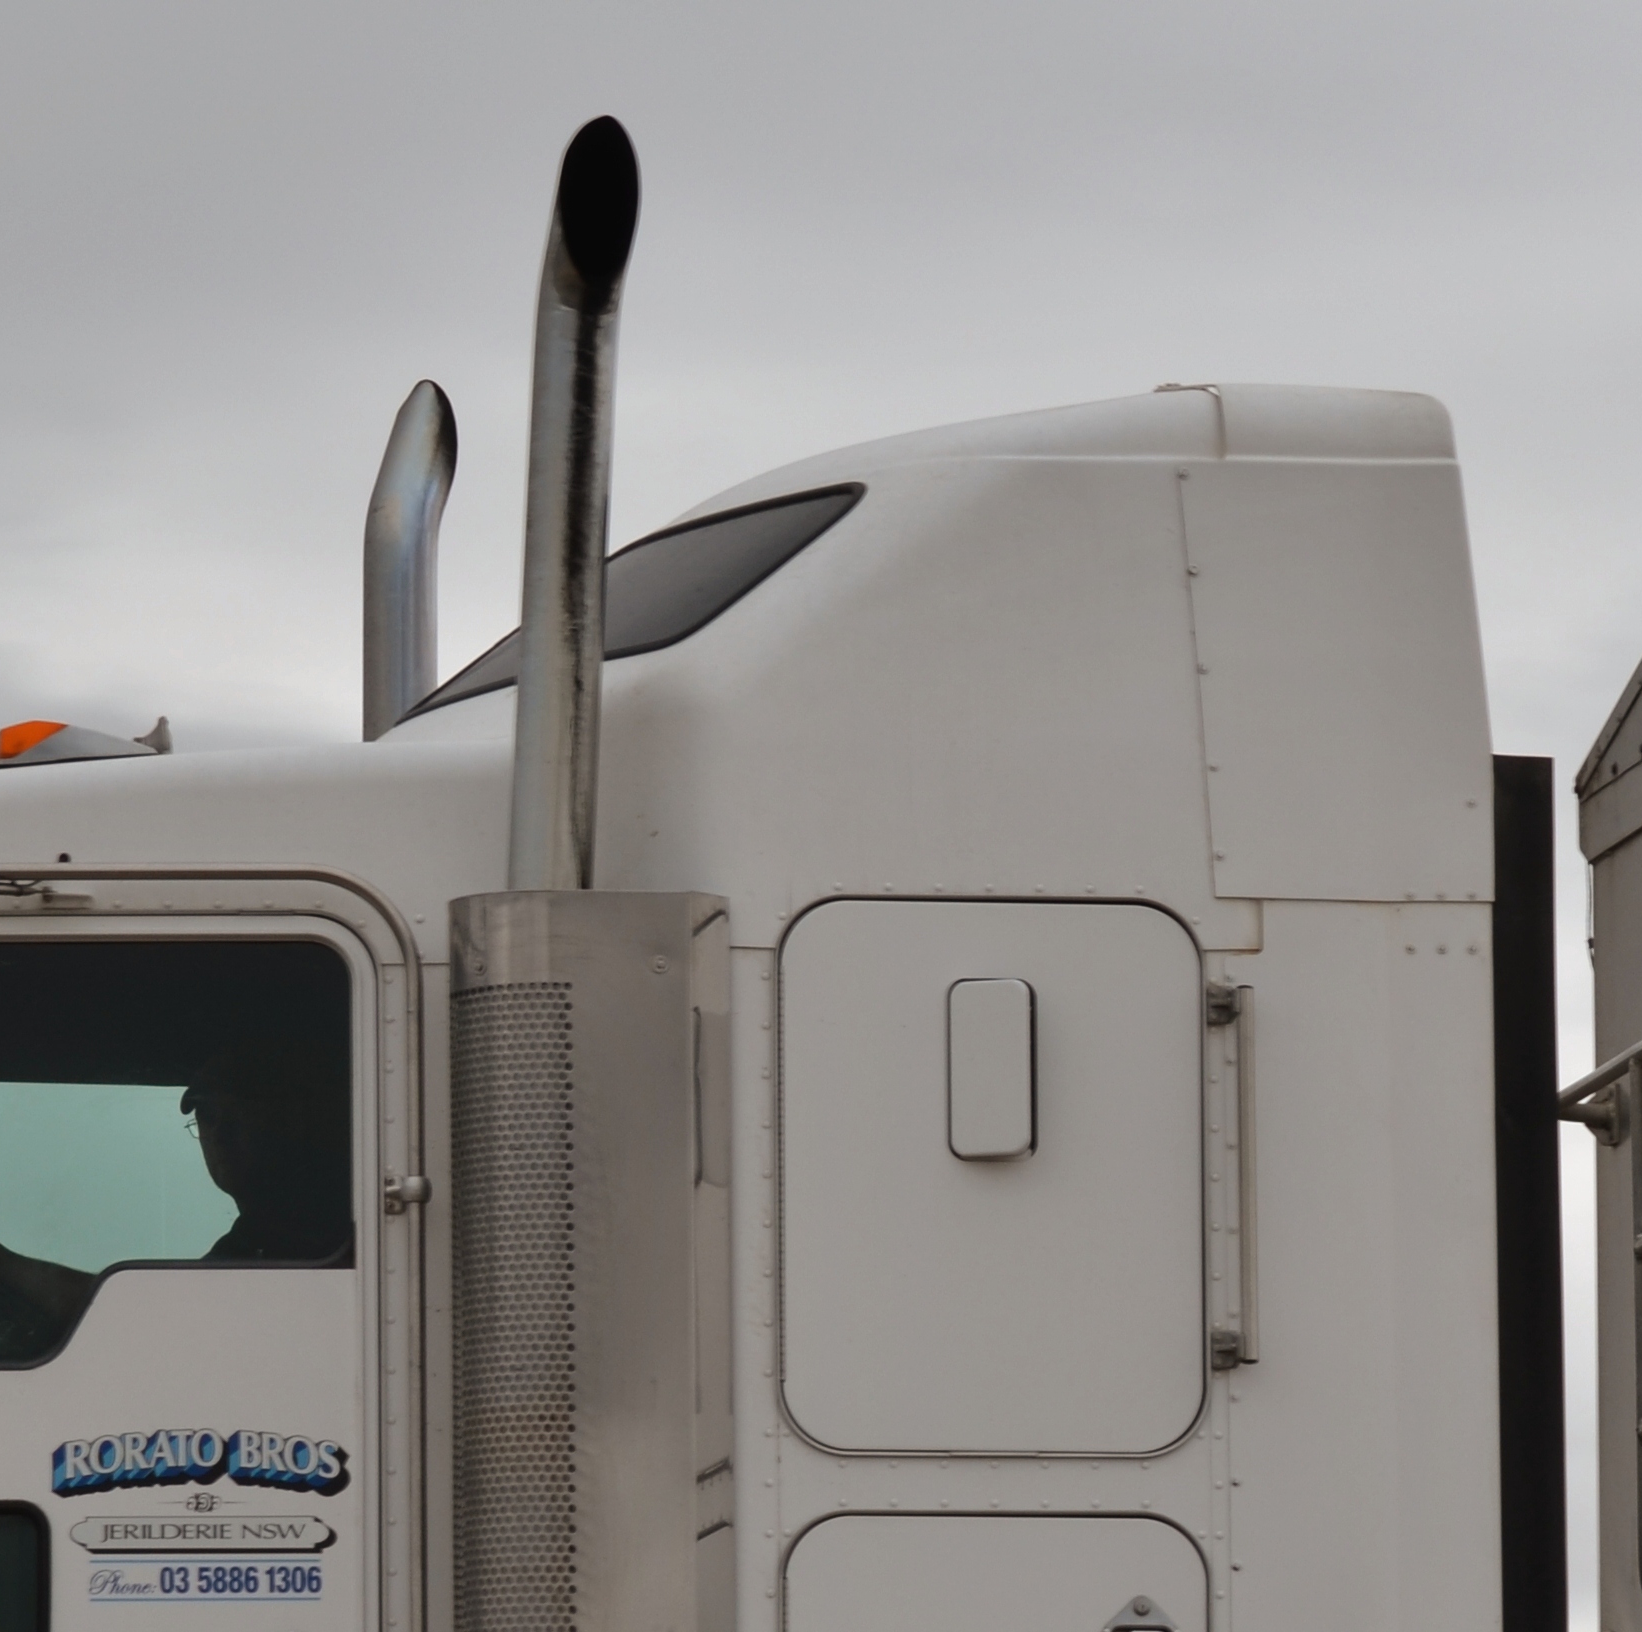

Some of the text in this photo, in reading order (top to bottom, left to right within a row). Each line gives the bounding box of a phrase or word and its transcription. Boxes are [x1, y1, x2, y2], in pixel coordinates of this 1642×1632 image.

[55, 1428, 346, 1488] RORATO BROS
[101, 1522, 306, 1544] JERILDERIE NSW
[88, 1566, 322, 1596] Phone: 03 5886 1306
